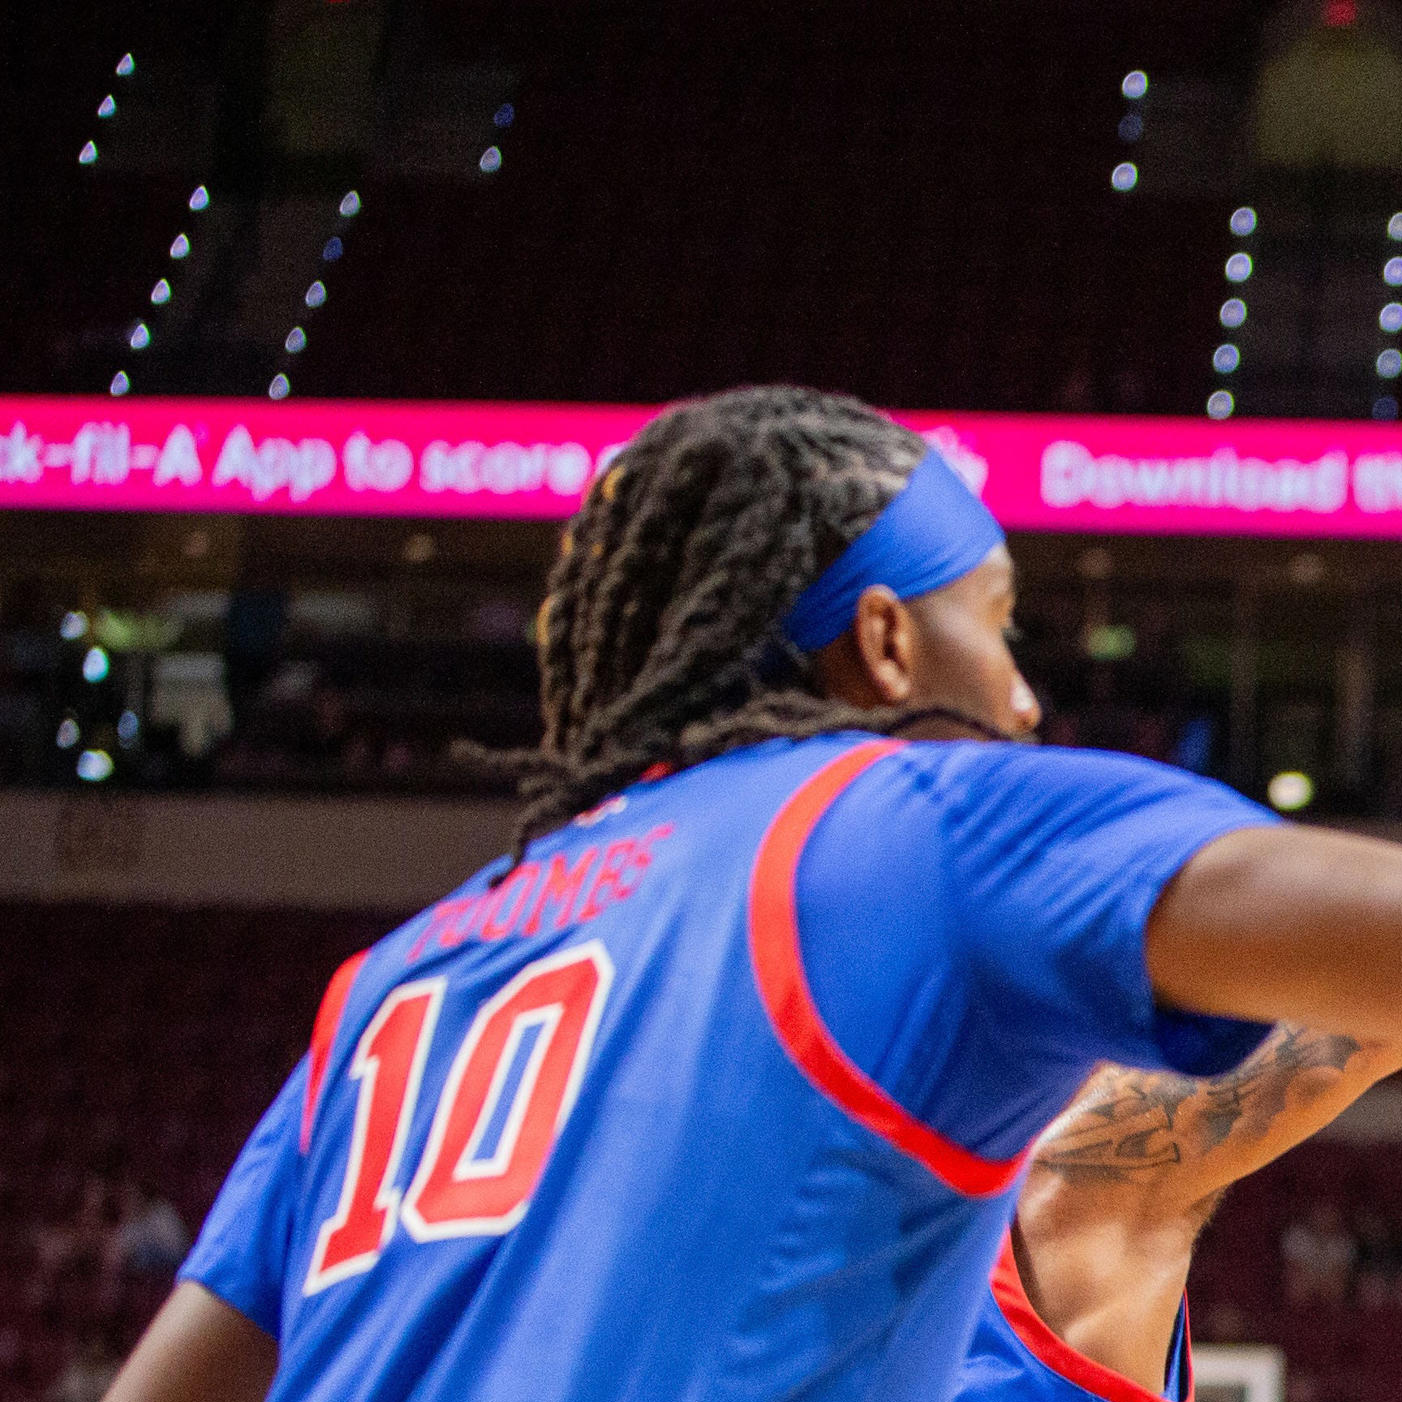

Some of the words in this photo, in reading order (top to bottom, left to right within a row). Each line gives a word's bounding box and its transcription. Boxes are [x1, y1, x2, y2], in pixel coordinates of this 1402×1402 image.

[212, 424, 336, 501] App
[343, 431, 413, 492] to
[420, 440, 592, 496] score
[1040, 440, 1350, 515] Download
[303, 938, 616, 1298] 10
